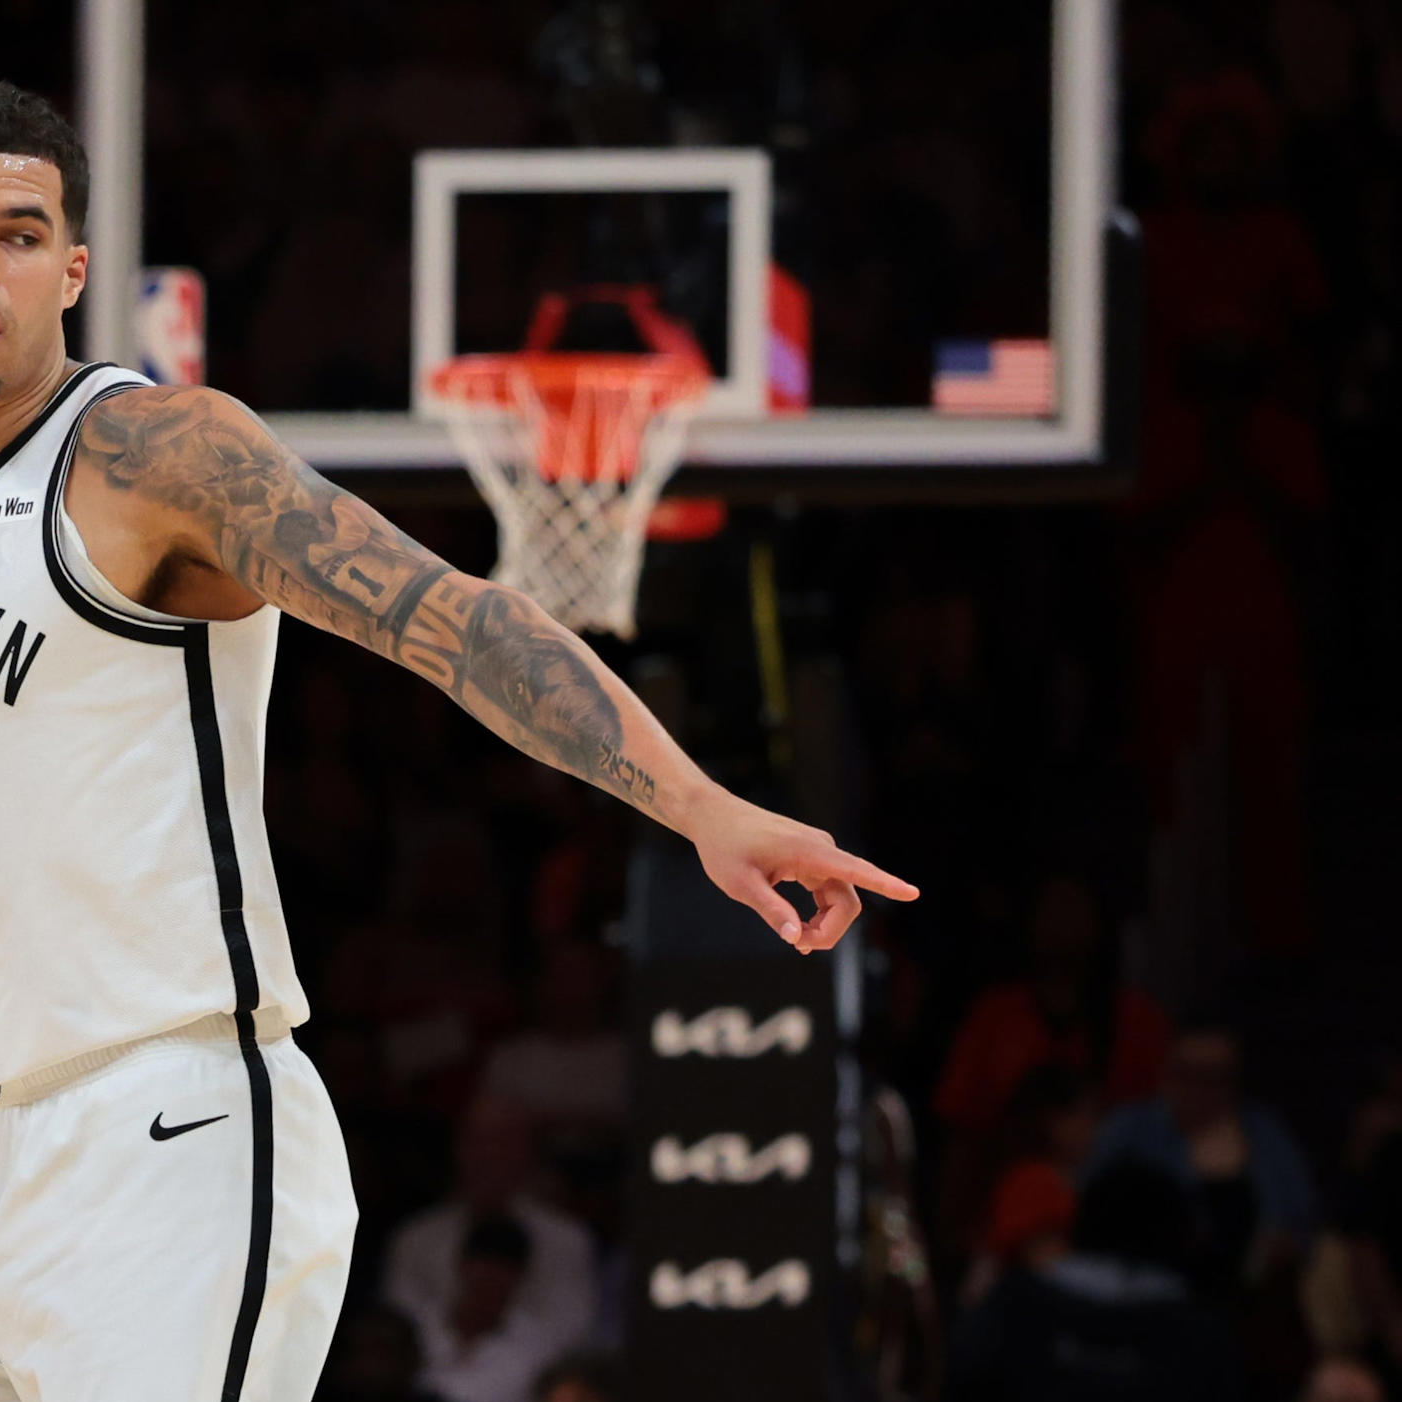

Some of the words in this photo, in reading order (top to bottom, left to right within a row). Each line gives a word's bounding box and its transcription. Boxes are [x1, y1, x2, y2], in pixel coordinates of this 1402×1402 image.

[5, 497, 34, 516] Won
[651, 1004, 813, 1059] KIA
[650, 1131, 813, 1185] KIA
[649, 1257, 812, 1311] KIA
